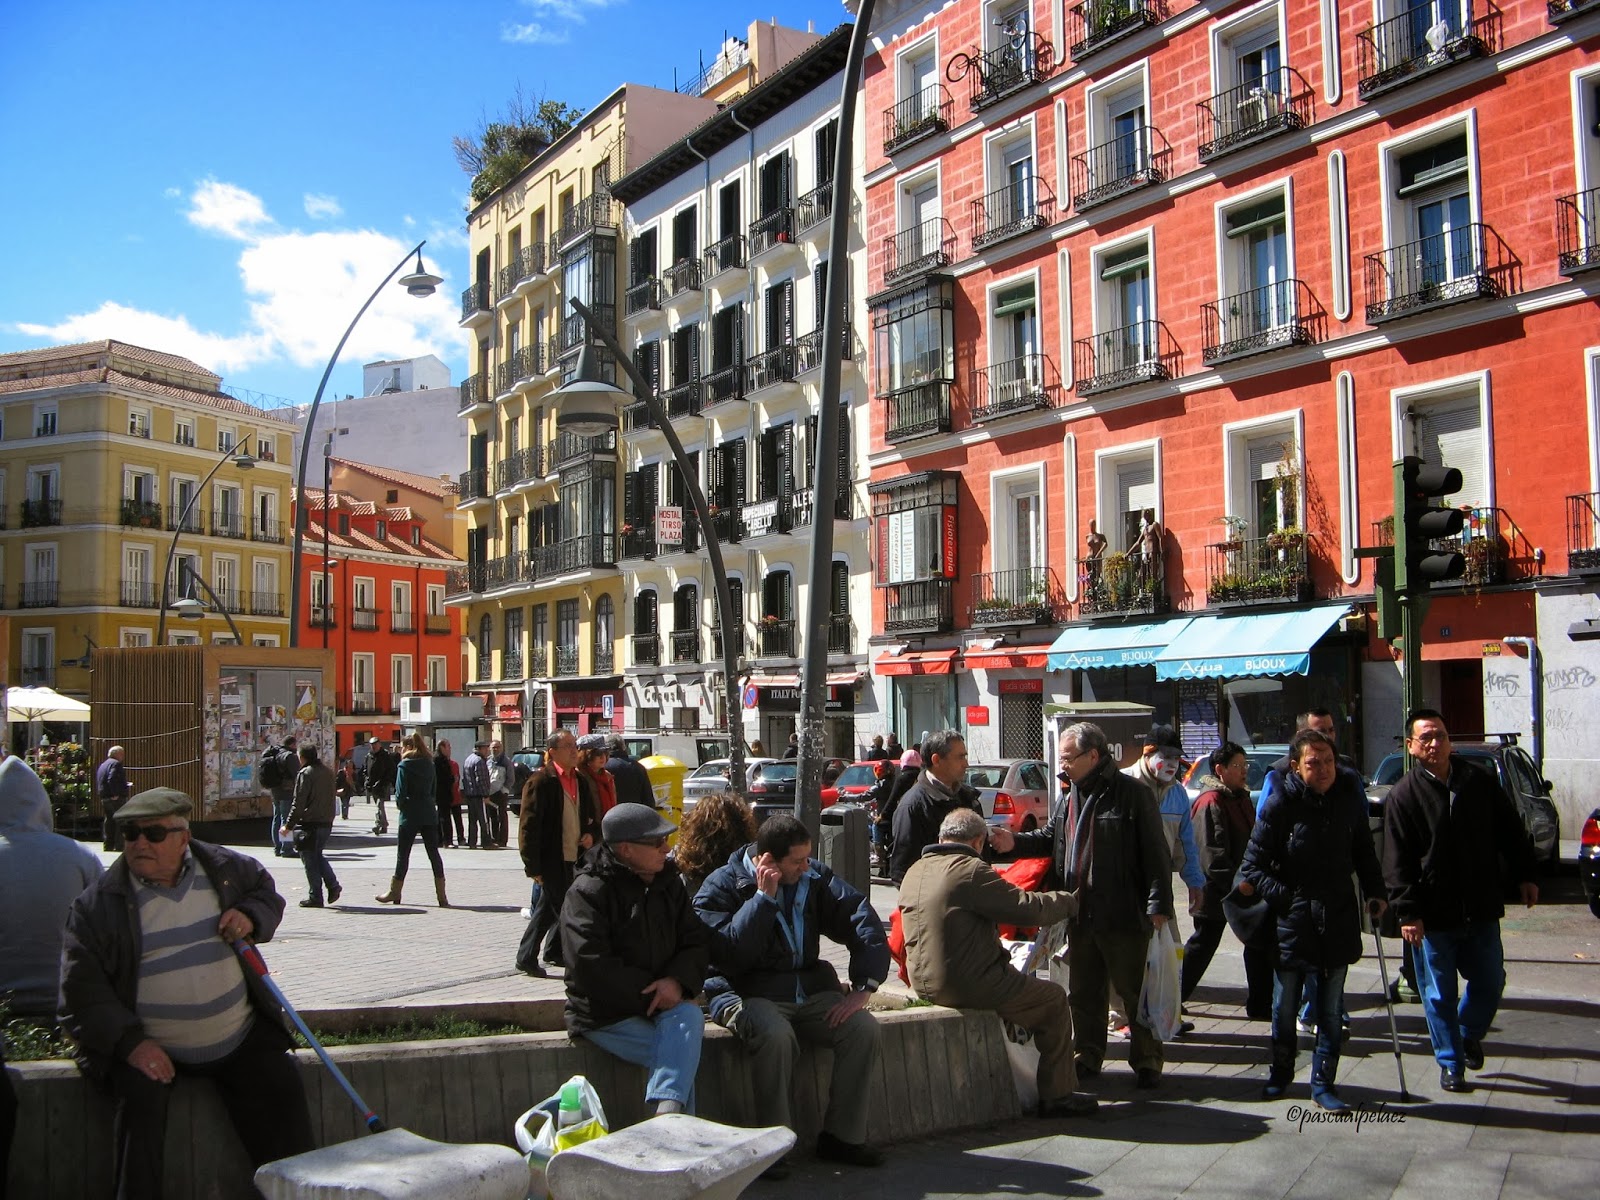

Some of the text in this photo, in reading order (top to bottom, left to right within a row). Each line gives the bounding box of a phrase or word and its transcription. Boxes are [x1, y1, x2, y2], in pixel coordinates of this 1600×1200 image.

[659, 510, 681, 519] HOSTAL
[661, 520, 682, 529] TIRSO
[747, 516, 772, 531] CABELLO
[660, 531, 682, 540] PLAZA
[947, 515, 955, 572] Fisioterapia
[1065, 651, 1155, 666] Aqua BIJOUX
[1177, 658, 1286, 675] Aqua BIJOUX
[771, 689, 791, 699] ITALY
